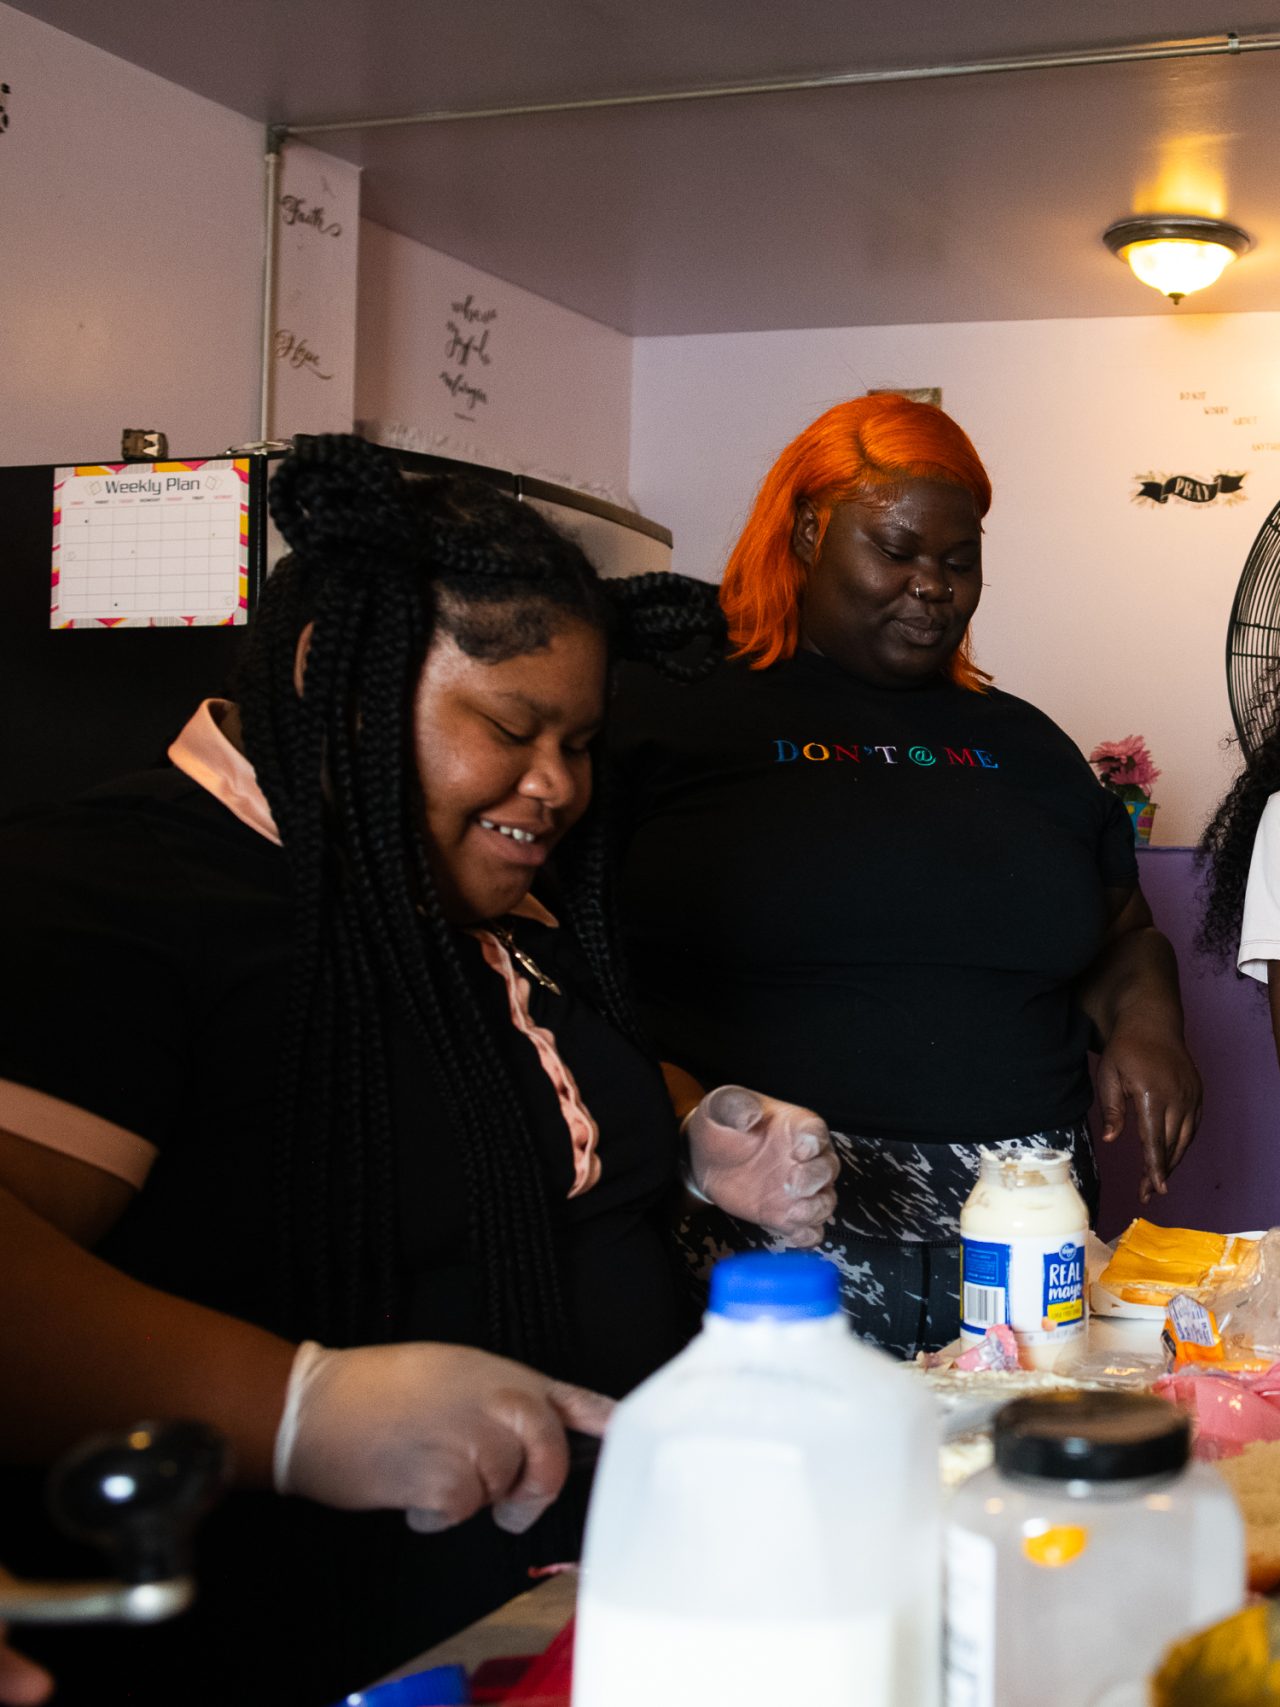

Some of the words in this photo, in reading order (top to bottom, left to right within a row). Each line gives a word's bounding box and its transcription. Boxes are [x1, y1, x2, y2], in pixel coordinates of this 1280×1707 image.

[105, 479, 162, 495] Weekly
[166, 477, 200, 492] Plan
[1174, 477, 1210, 500] PRAY
[773, 740, 898, 765] DON'T
[944, 746, 999, 769] ME
[1049, 1261, 1082, 1287] REAL
